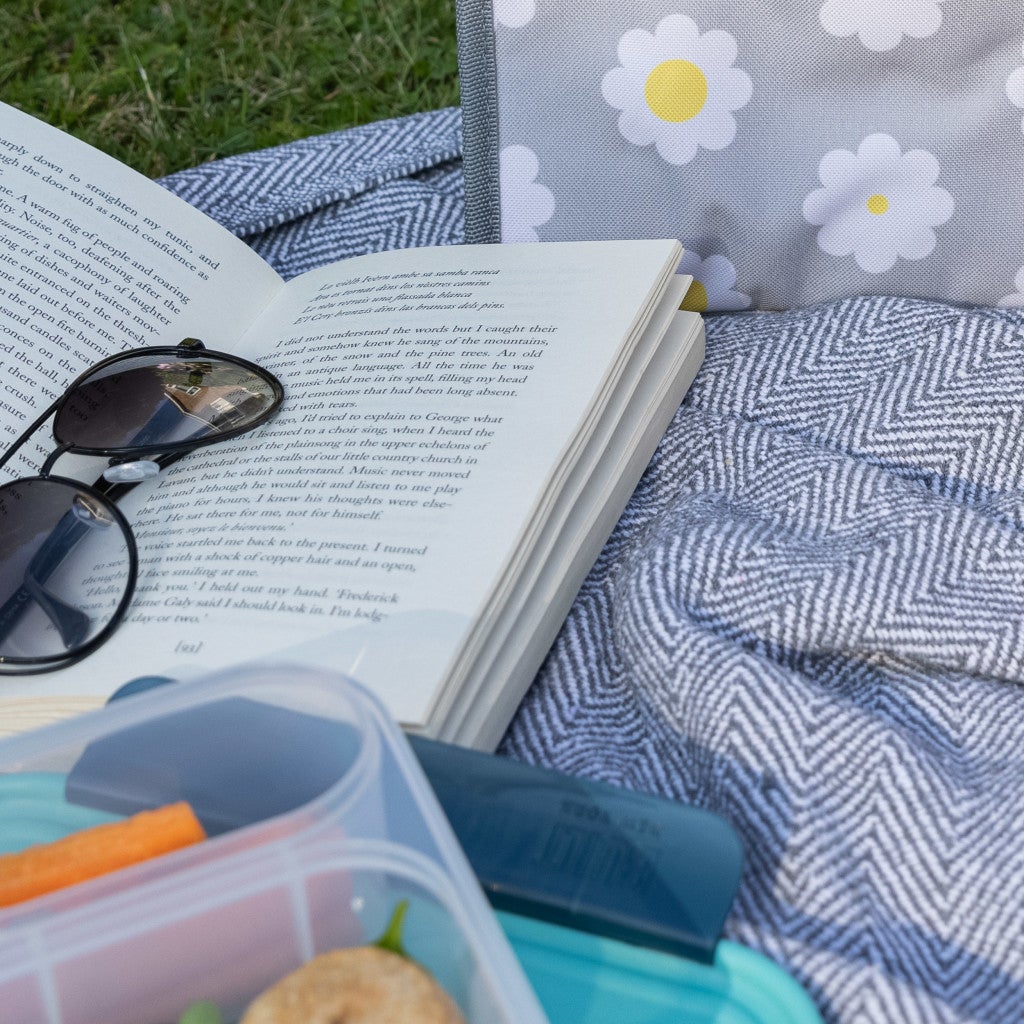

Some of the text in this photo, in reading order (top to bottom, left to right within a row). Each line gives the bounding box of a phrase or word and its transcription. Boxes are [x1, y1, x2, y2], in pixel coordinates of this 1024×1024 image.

[22, 164, 40, 177] the
[42, 175, 69, 192] door
[70, 190, 94, 207] with
[96, 207, 108, 215] as
[109, 213, 140, 234] much
[141, 232, 197, 272] confidence
[197, 271, 210, 281] as
[33, 155, 64, 174] down
[69, 173, 81, 184] to
[85, 183, 138, 217] straighten
[143, 217, 162, 231] my
[165, 231, 193, 254] tunic,
[198, 254, 220, 270] and
[16, 194, 191, 305] A warm fug of people and roaring
[19, 210, 53, 235] Noise,
[57, 233, 77, 249] too,
[81, 247, 135, 284] deafening
[136, 281, 162, 299] after
[163, 300, 181, 315] the
[20, 248, 38, 257] of
[35, 255, 69, 277] dishes
[70, 277, 93, 291] and
[94, 289, 132, 316] waiters
[133, 313, 161, 336] mov-
[20, 265, 76, 298] entranced
[76, 297, 91, 308] on
[93, 306, 111, 321] the
[53, 248, 112, 285] cacophony
[114, 284, 130, 294] of
[128, 292, 172, 326] laughter
[8, 292, 27, 306] the
[27, 304, 56, 323] open
[56, 320, 76, 335] fire
[16, 278, 40, 295] laid
[40, 293, 60, 307] out
[61, 303, 96, 329] before
[97, 328, 116, 344] me.
[30, 323, 72, 351] candles
[276, 340, 283, 348] I
[284, 337, 303, 346] did
[327, 328, 390, 339] understand
[453, 325, 472, 333] but
[486, 325, 525, 334] caught
[529, 325, 558, 333] their
[284, 346, 306, 356] and
[307, 343, 361, 353] somehow
[363, 340, 395, 348] knew
[415, 339, 442, 347] sang
[445, 337, 461, 345] of
[461, 337, 480, 345] the
[484, 337, 549, 346] mountains,
[14, 351, 58, 383] the hall,
[38, 346, 54, 359] on
[58, 358, 76, 374] the
[302, 356, 318, 364] of
[319, 355, 338, 363] the
[377, 350, 401, 358] and
[405, 349, 424, 357] the
[427, 350, 455, 359] pine
[496, 349, 516, 357] An
[522, 349, 543, 358] old
[305, 366, 348, 375] antique
[352, 363, 405, 372] language.
[411, 361, 431, 369] All
[435, 361, 454, 369] the
[460, 362, 487, 370] time
[492, 362, 507, 370] he
[8, 366, 37, 387] there
[290, 378, 324, 389] music
[325, 376, 353, 385] held
[437, 374, 474, 384] filling
[498, 375, 528, 384] head
[5, 384, 37, 409] crush.
[308, 389, 361, 398] emotions
[363, 387, 387, 395] that
[390, 386, 414, 395] had
[415, 387, 443, 395] been
[447, 387, 474, 397] long
[476, 388, 518, 397] absent.
[300, 402, 325, 411] with
[319, 413, 347, 421] tried
[364, 412, 406, 422] explain
[425, 412, 470, 424] George
[473, 415, 504, 424] what
[258, 428, 302, 438] listened
[328, 426, 359, 434] choir
[392, 426, 424, 435] when
[429, 426, 435, 434] I
[437, 427, 473, 436] heard
[475, 428, 495, 437] the
